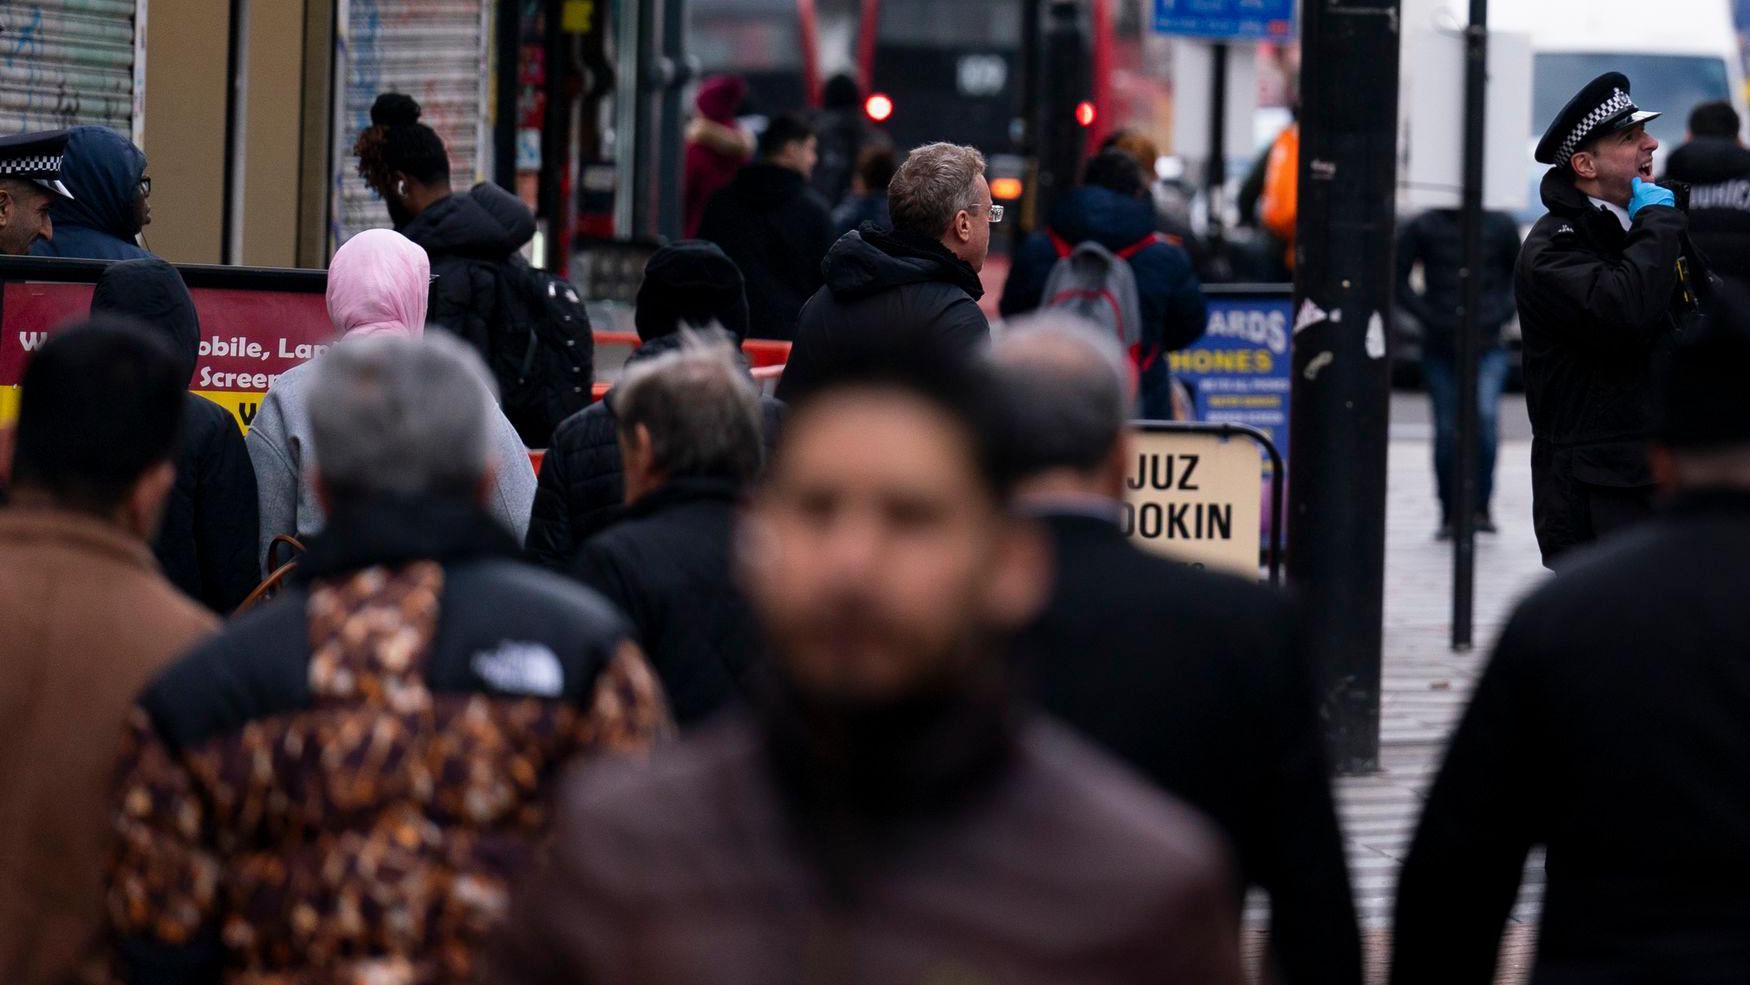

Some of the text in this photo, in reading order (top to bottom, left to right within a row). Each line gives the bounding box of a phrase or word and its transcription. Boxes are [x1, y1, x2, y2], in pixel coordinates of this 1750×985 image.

[198, 336, 270, 361] obile,
[1206, 310, 1286, 354] ARDS
[1169, 348, 1273, 374] HONES
[1127, 453, 1200, 491] JUZ
[1117, 502, 1231, 539] OOKIN
